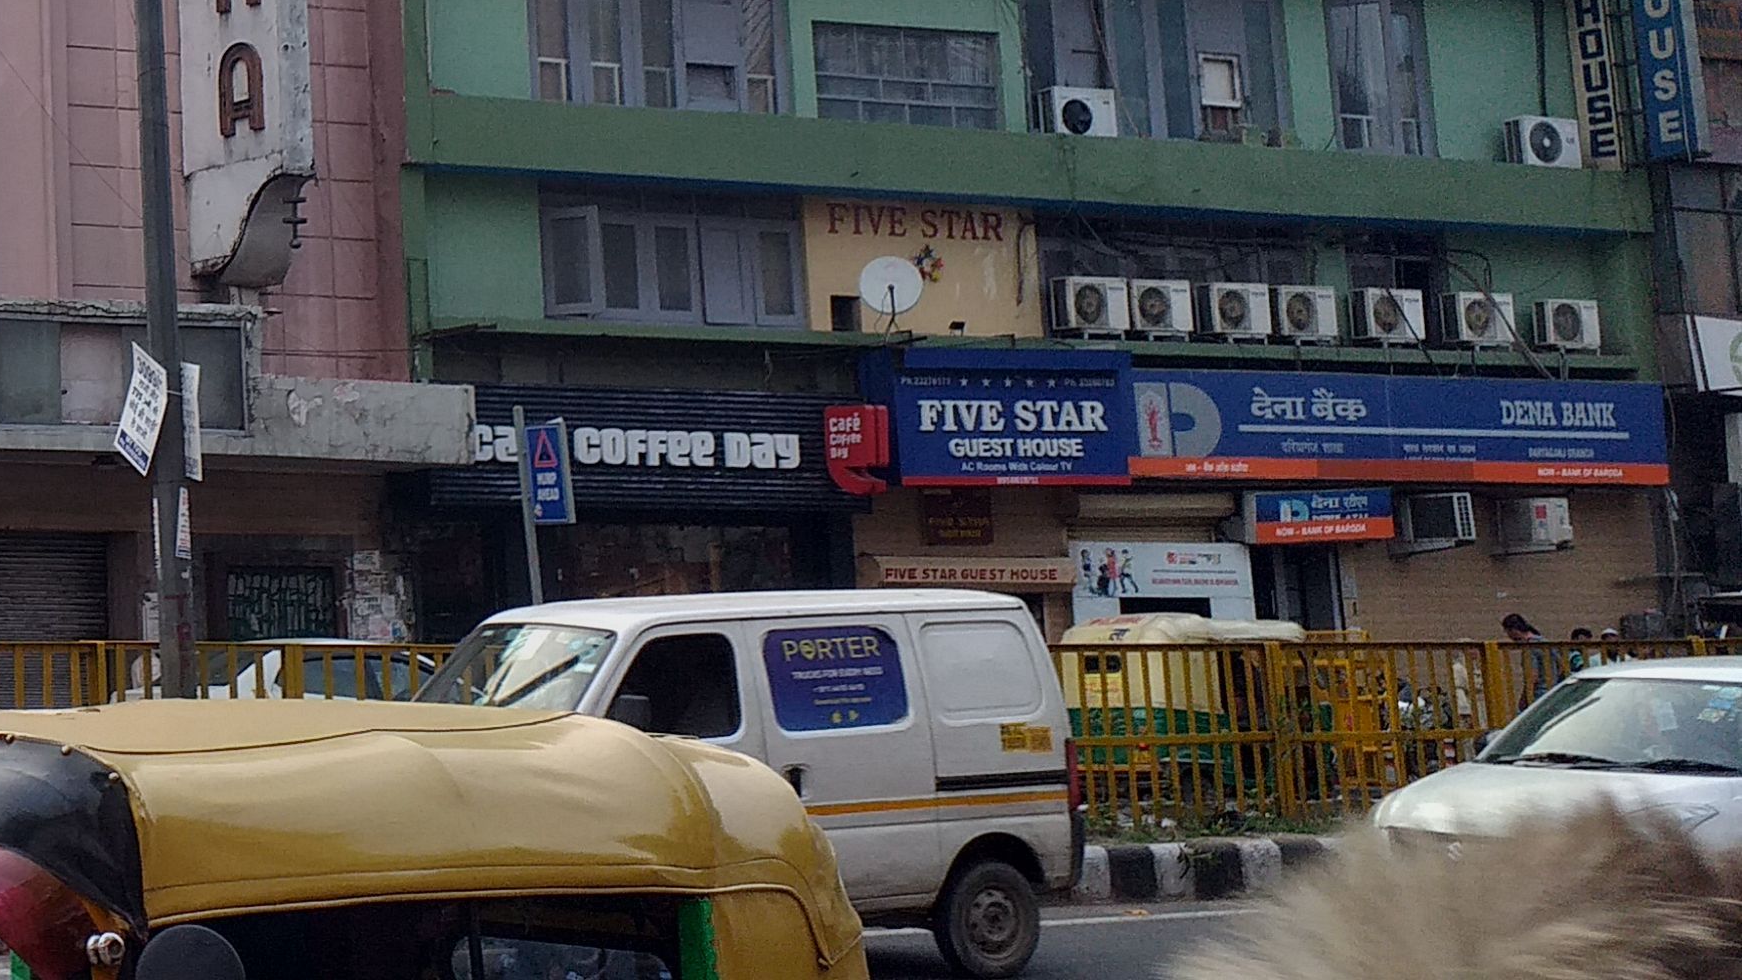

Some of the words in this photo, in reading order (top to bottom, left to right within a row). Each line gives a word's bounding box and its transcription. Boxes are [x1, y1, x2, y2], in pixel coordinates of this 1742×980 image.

[826, 203, 908, 238] FIVE
[920, 209, 1004, 241] STAR
[918, 400, 1005, 432] FIVE
[1014, 400, 1108, 432] STAR
[1250, 387, 1305, 421] देना
[1311, 386, 1368, 421] बैंक
[1500, 399, 1558, 426] DENA
[1562, 401, 1616, 428] BANK
[948, 438, 1015, 458] GUEST
[1016, 438, 1085, 458] HOUSE
[1275, 527, 1295, 537] NOW
[1301, 526, 1323, 536] BANK
[1324, 525, 1335, 535] OF
[1335, 523, 1367, 534] BARODA
[885, 568, 918, 581] FIVE
[921, 568, 958, 581] STAR
[960, 569, 1006, 581] GUEST
[1009, 569, 1059, 581] HOUSE
[782, 635, 881, 662] PORTER
